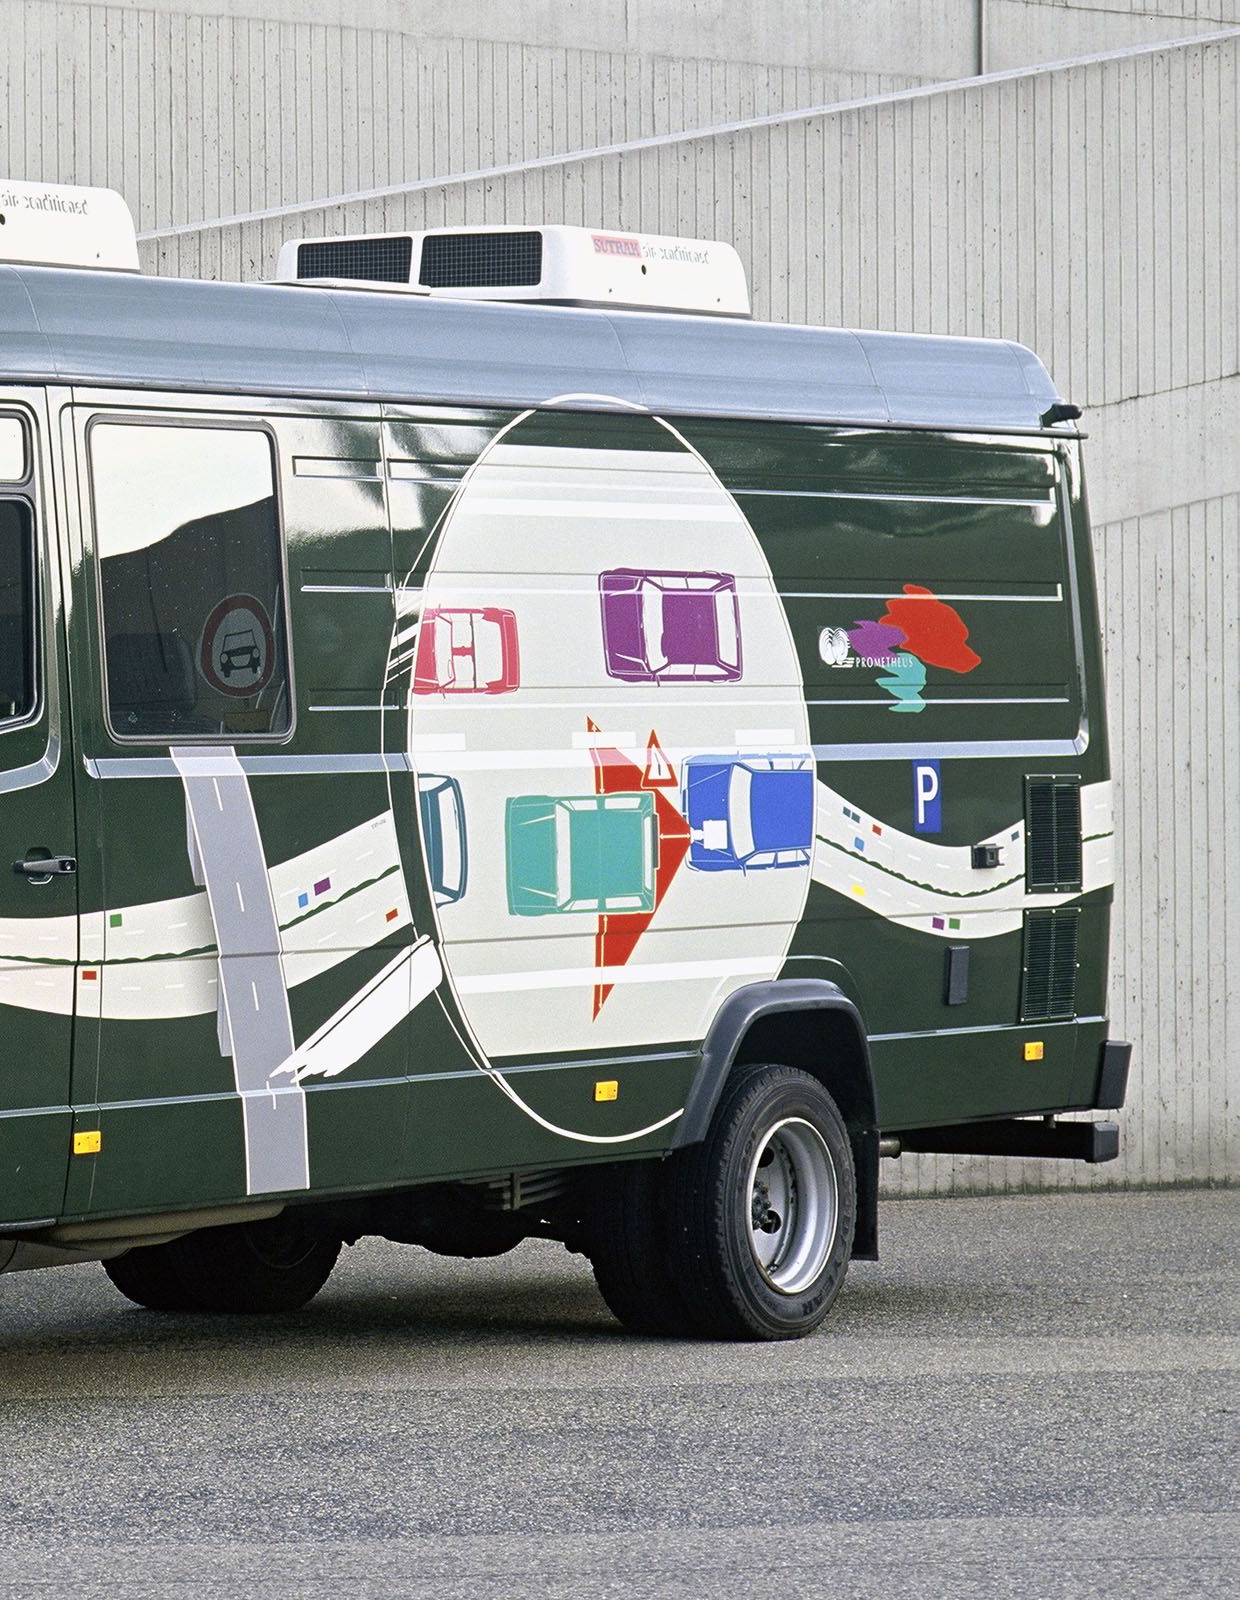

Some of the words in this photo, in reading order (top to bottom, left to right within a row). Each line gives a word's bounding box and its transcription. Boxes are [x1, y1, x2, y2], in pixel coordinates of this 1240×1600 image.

[592, 238, 642, 257] SUTRAK
[855, 657, 913, 668] PROMETHEUS
[917, 766, 938, 824] P
